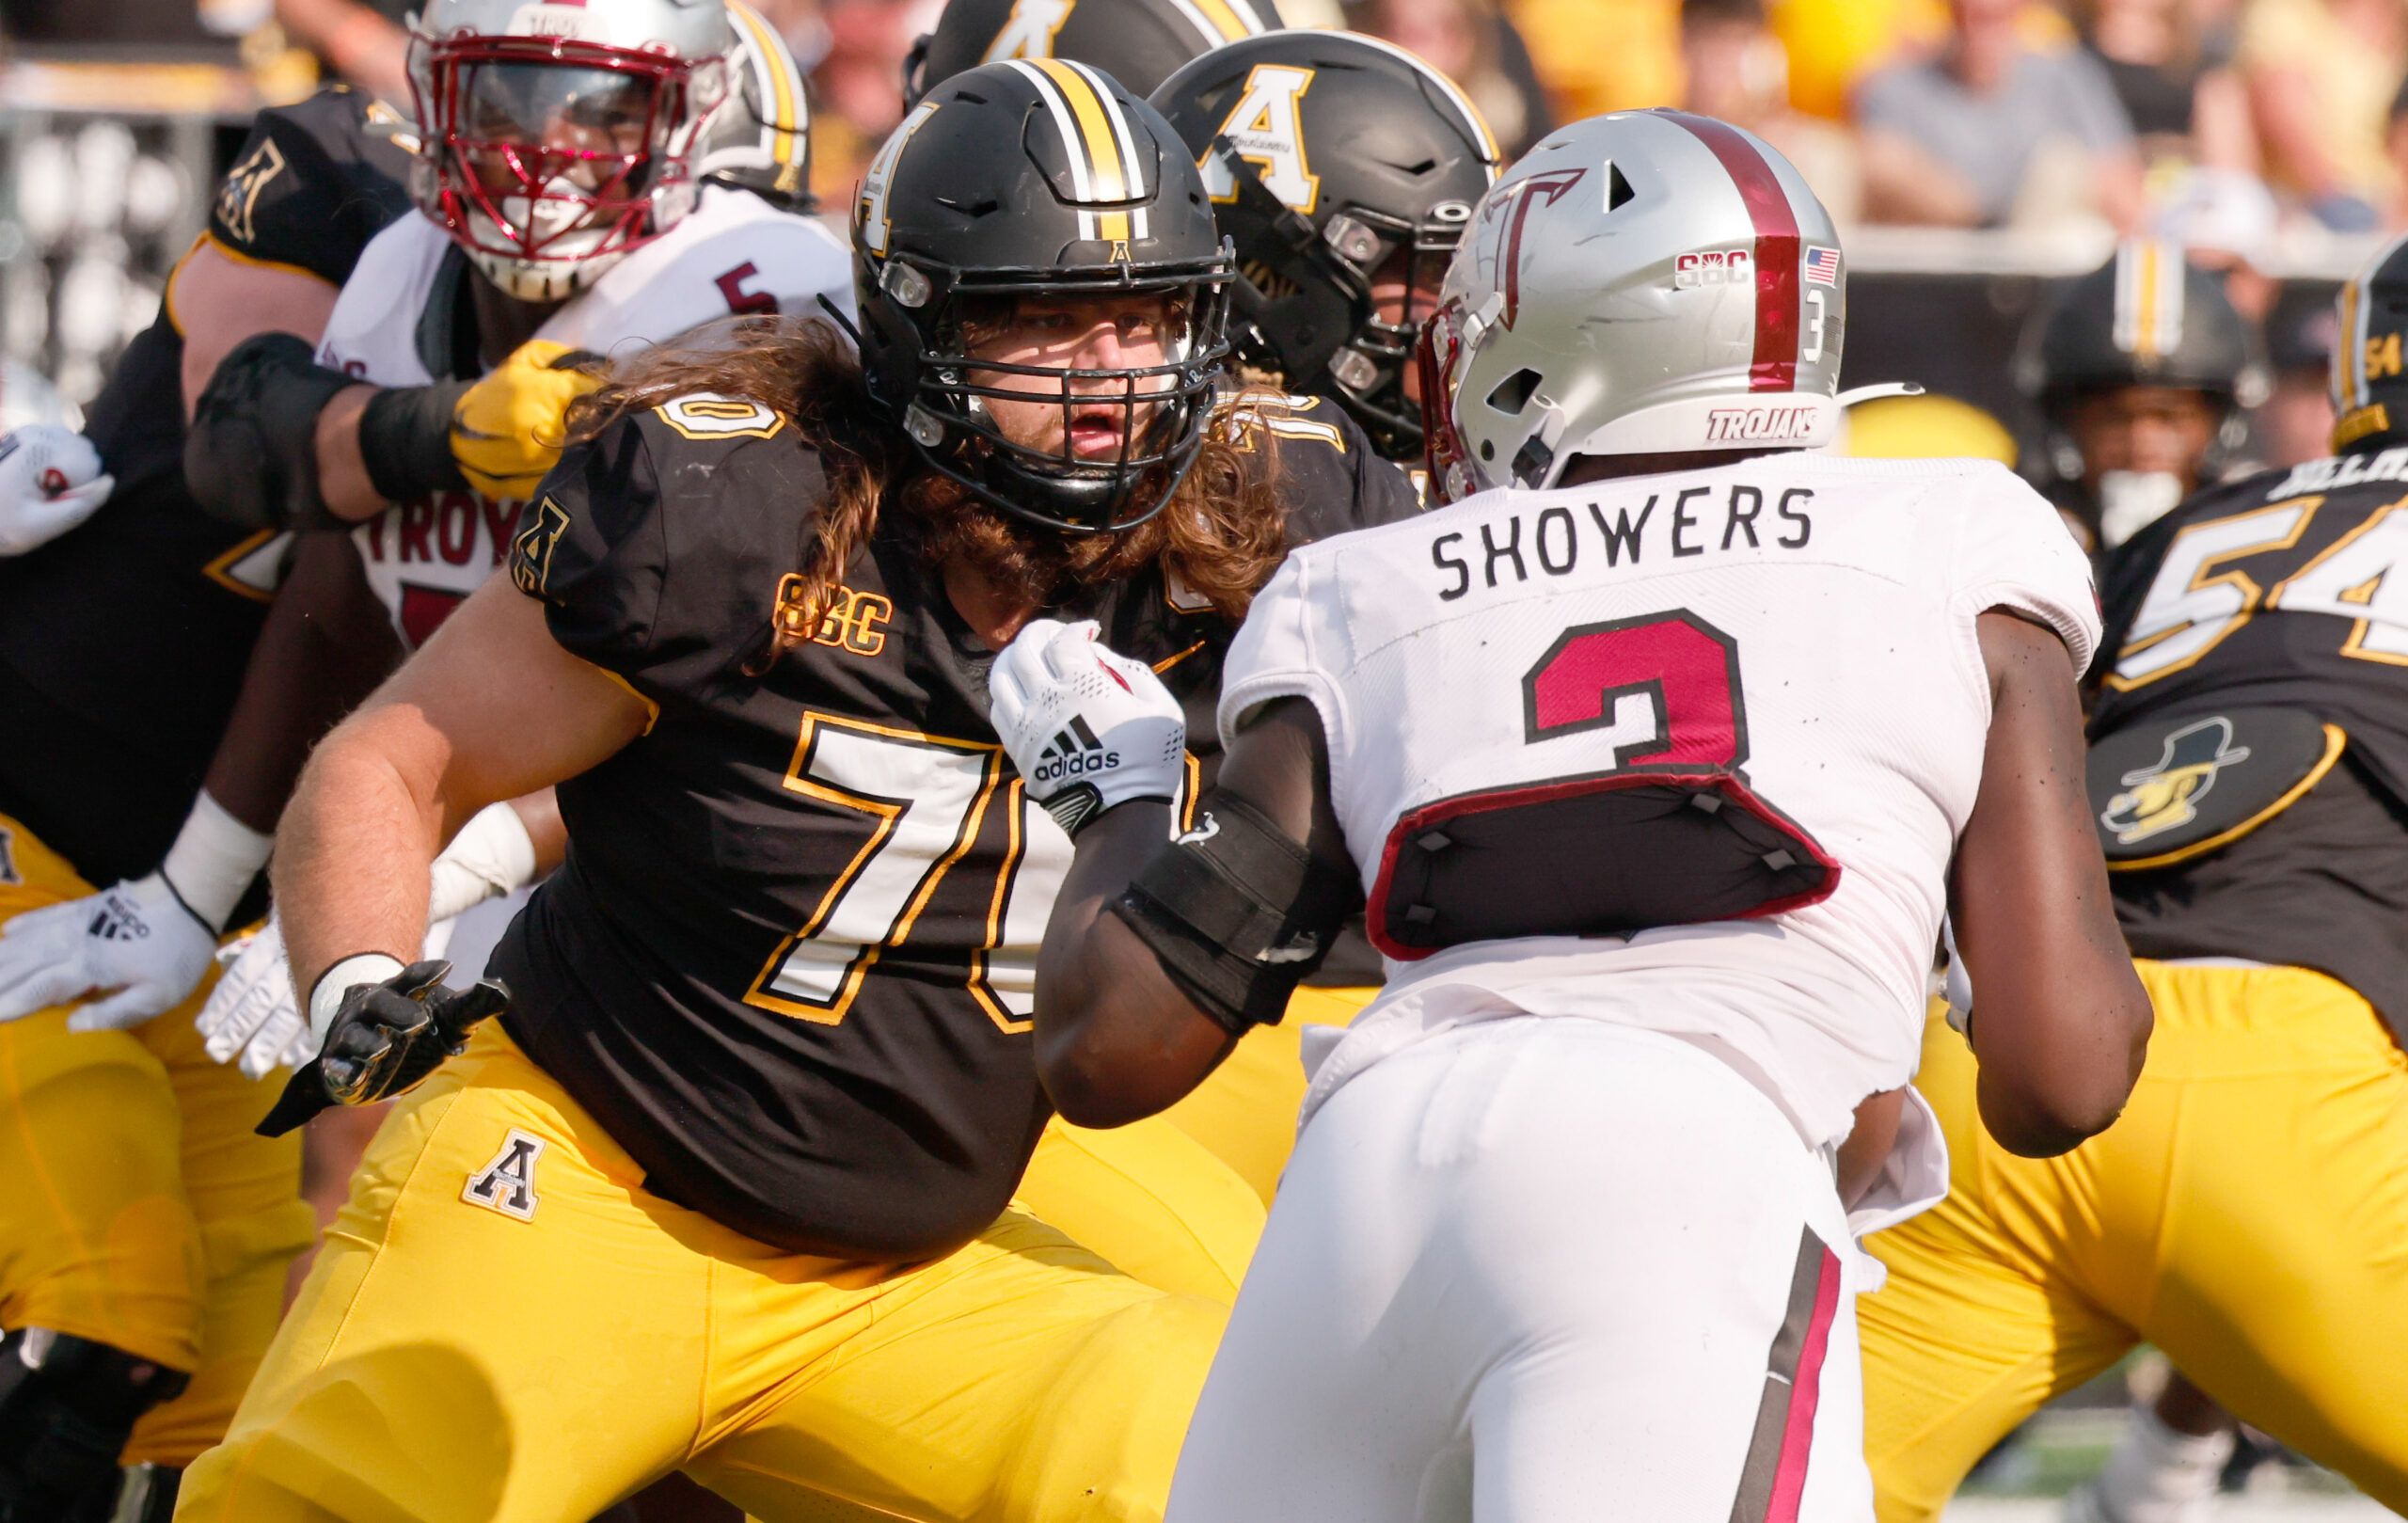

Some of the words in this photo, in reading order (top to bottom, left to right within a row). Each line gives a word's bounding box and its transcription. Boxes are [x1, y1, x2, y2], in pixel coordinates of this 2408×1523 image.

[1195, 63, 1321, 215] A
[1675, 248, 1751, 290] SBC
[1802, 289, 1826, 365] 3
[1706, 407, 1818, 441] TROJANS
[1432, 484, 1815, 602] SHOWERS
[2101, 495, 2408, 693] 54
[1034, 752, 1120, 781] adidas
[468, 1132, 543, 1216] A
